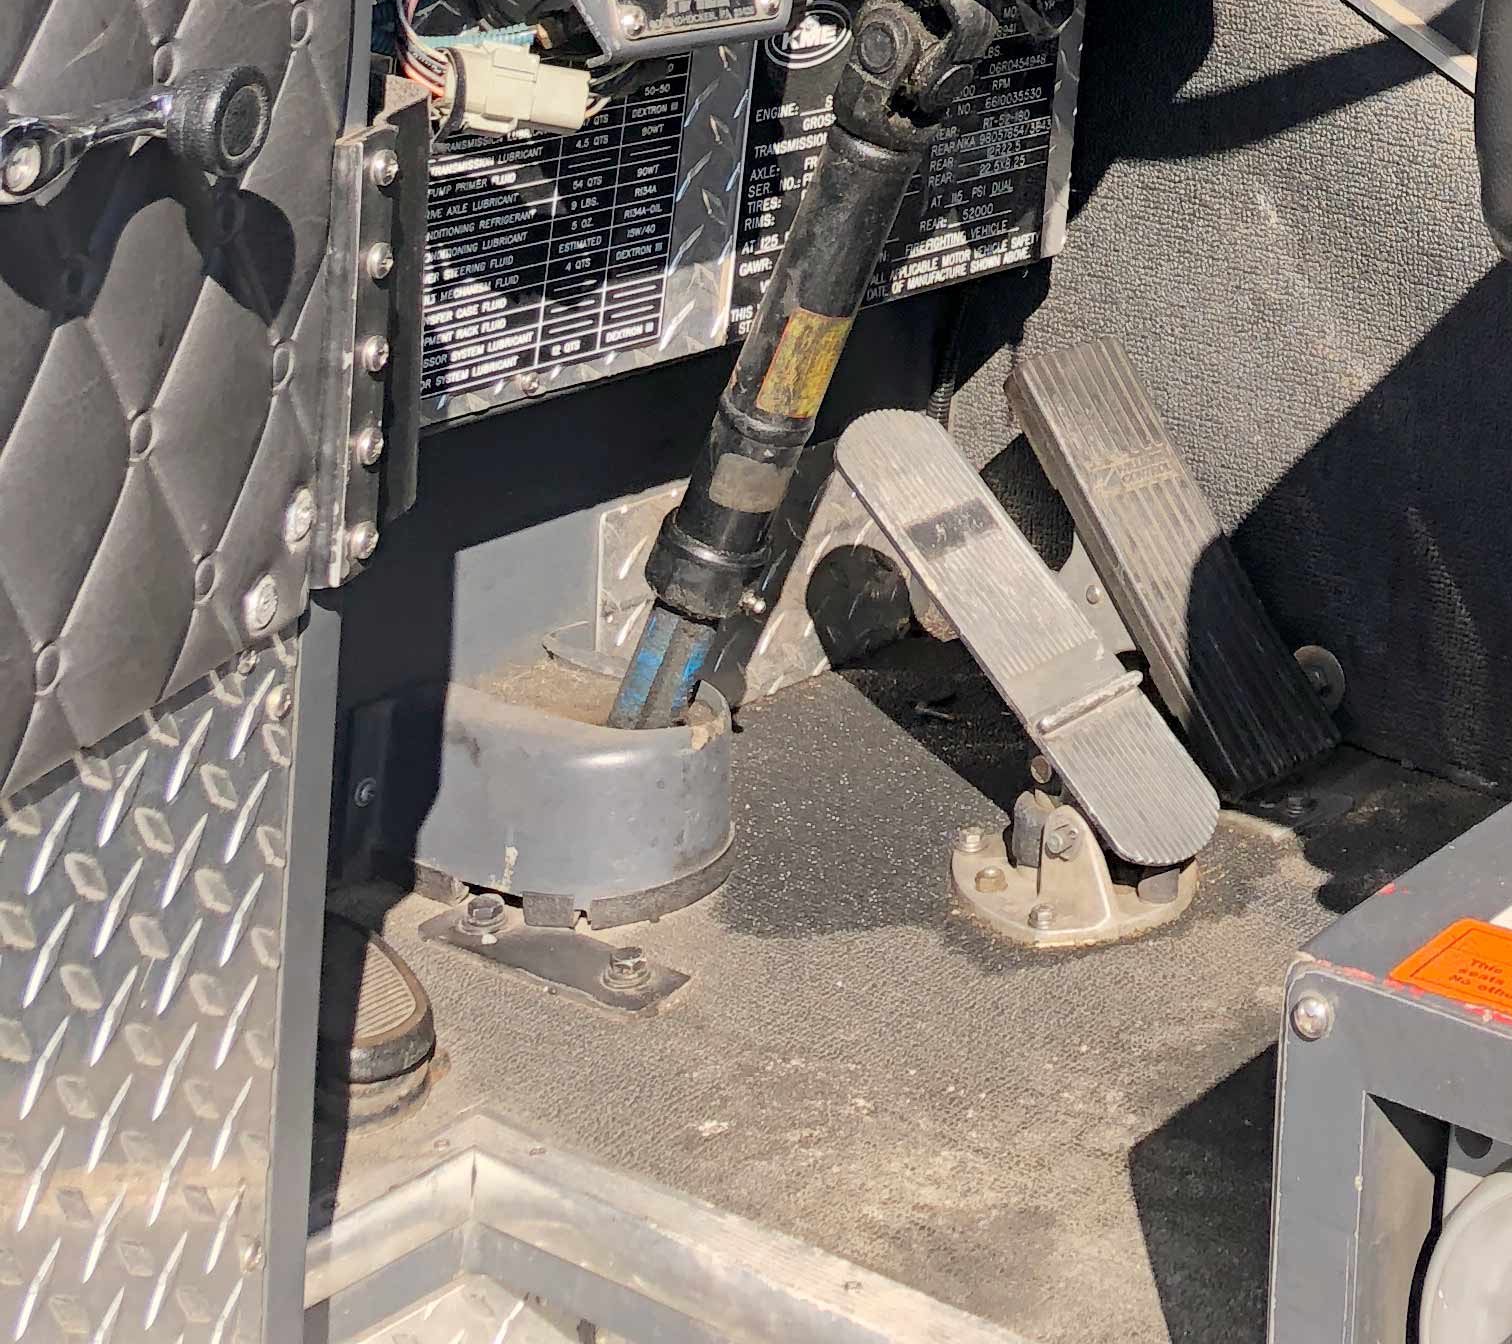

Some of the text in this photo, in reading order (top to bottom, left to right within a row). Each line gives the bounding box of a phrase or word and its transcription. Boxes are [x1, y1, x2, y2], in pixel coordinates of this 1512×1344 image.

[781, 24, 838, 50] KME
[644, 83, 671, 97] 50-50
[594, 113, 609, 126] QTS
[631, 105, 668, 118] DEXTRON
[755, 102, 799, 123] ENGINE:
[593, 135, 609, 147] QTS
[429, 146, 544, 177] TRANSMISSION LUBRICANT
[455, 178, 488, 192] PRIMER
[490, 171, 517, 186] FLUID
[587, 175, 603, 188] QTS
[750, 164, 780, 182] AXLE:
[748, 182, 772, 199] SER.
[931, 195, 943, 209] AT
[971, 187, 986, 199] PSI
[992, 179, 1013, 193] DUAL
[446, 192, 520, 216] AXLE LUBRICANT
[747, 198, 782, 215] TIRES:
[426, 209, 537, 242] NDITIONING REFRIGERANT
[744, 213, 775, 231] RIMS:
[919, 203, 994, 232] REAR: 52000
[482, 231, 528, 250] LUBRICANT
[559, 236, 602, 253] ESTIMATED
[741, 234, 778, 255] AT 125
[905, 220, 1008, 256] FIREFIGHTING VEHICLE
[616, 245, 652, 260] DEXTRON
[889, 256, 943, 281] APPLICABLE
[941, 249, 971, 268] MOTOR
[973, 240, 1008, 260] VEHICLE
[1010, 232, 1040, 247] SAFETY
[443, 261, 486, 281] STEERING
[490, 255, 514, 269] FLUID
[575, 257, 591, 270] QTS
[739, 258, 773, 277] GAWR:
[891, 280, 906, 295] OF
[906, 265, 967, 291] MANUFACTURE
[969, 255, 1000, 274] SHOWN
[440, 275, 519, 301] MECHANISM FLUID
[455, 297, 507, 319] CASE FLUID
[730, 306, 753, 323] THIS
[455, 318, 507, 340] RACK FLUID
[605, 327, 642, 343] DEXTRON
[450, 331, 534, 362] SYSTEM LUBRICANT
[564, 340, 581, 354] QTS
[435, 368, 469, 387] SYSTEM
[472, 355, 520, 377] LUBRICANT
[1469, 959, 1504, 975] This
[1449, 973, 1472, 986] No
[1457, 968, 1505, 986] seats
